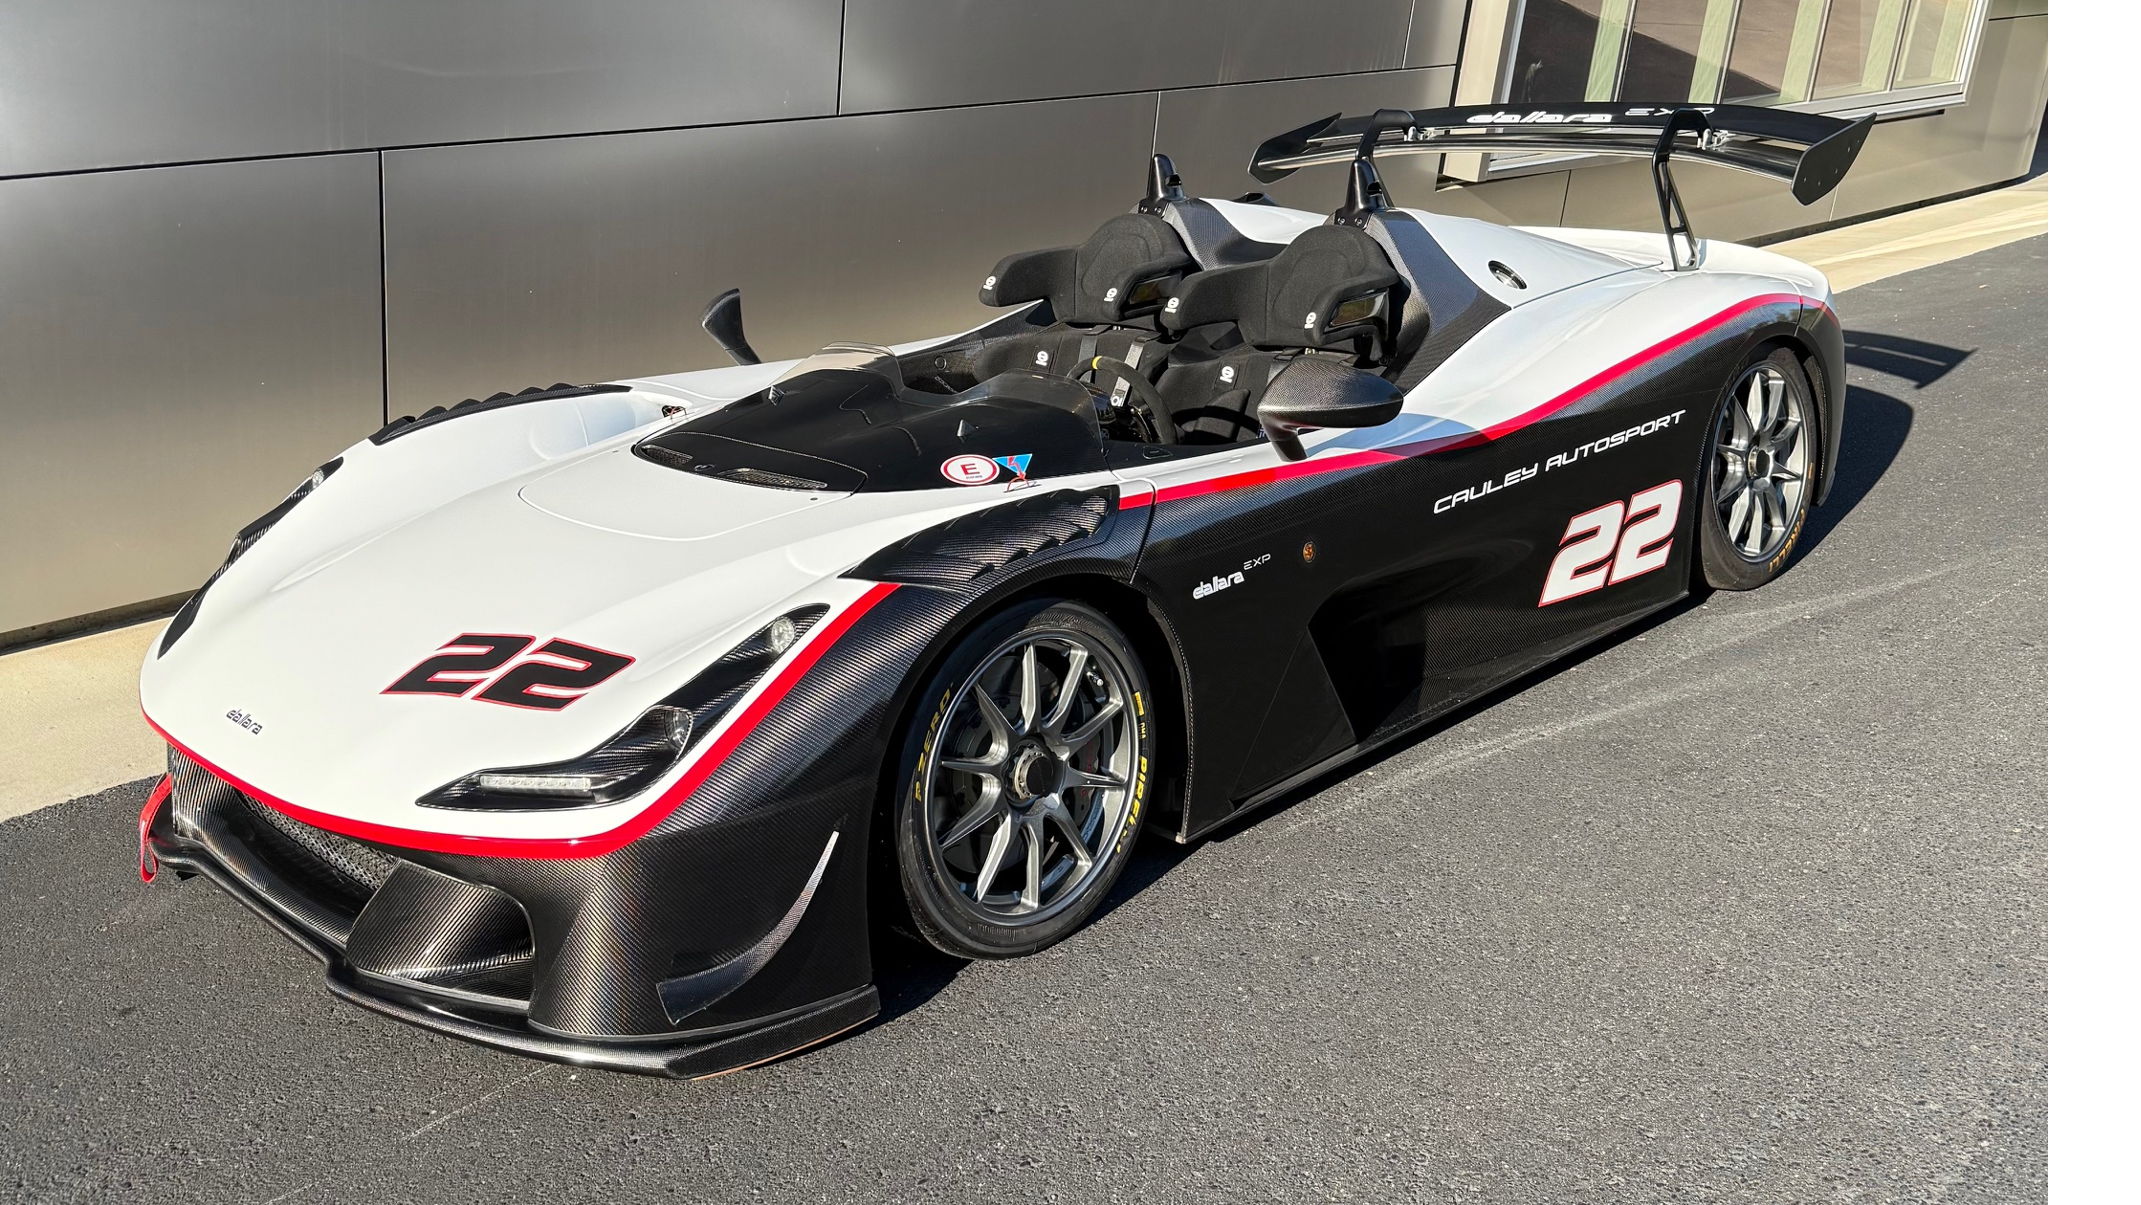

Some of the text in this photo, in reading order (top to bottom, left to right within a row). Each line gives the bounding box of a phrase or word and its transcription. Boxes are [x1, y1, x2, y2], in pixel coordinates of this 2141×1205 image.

[1467, 111, 1612, 123] dallara
[960, 463, 980, 475] E
[1434, 409, 1686, 514] CAULEY AUTOSPORT
[1537, 478, 1683, 608] 22
[1243, 553, 1271, 571] EXP
[1192, 571, 1245, 600] dallara
[379, 632, 636, 712] 22
[226, 708, 263, 735] dallara
